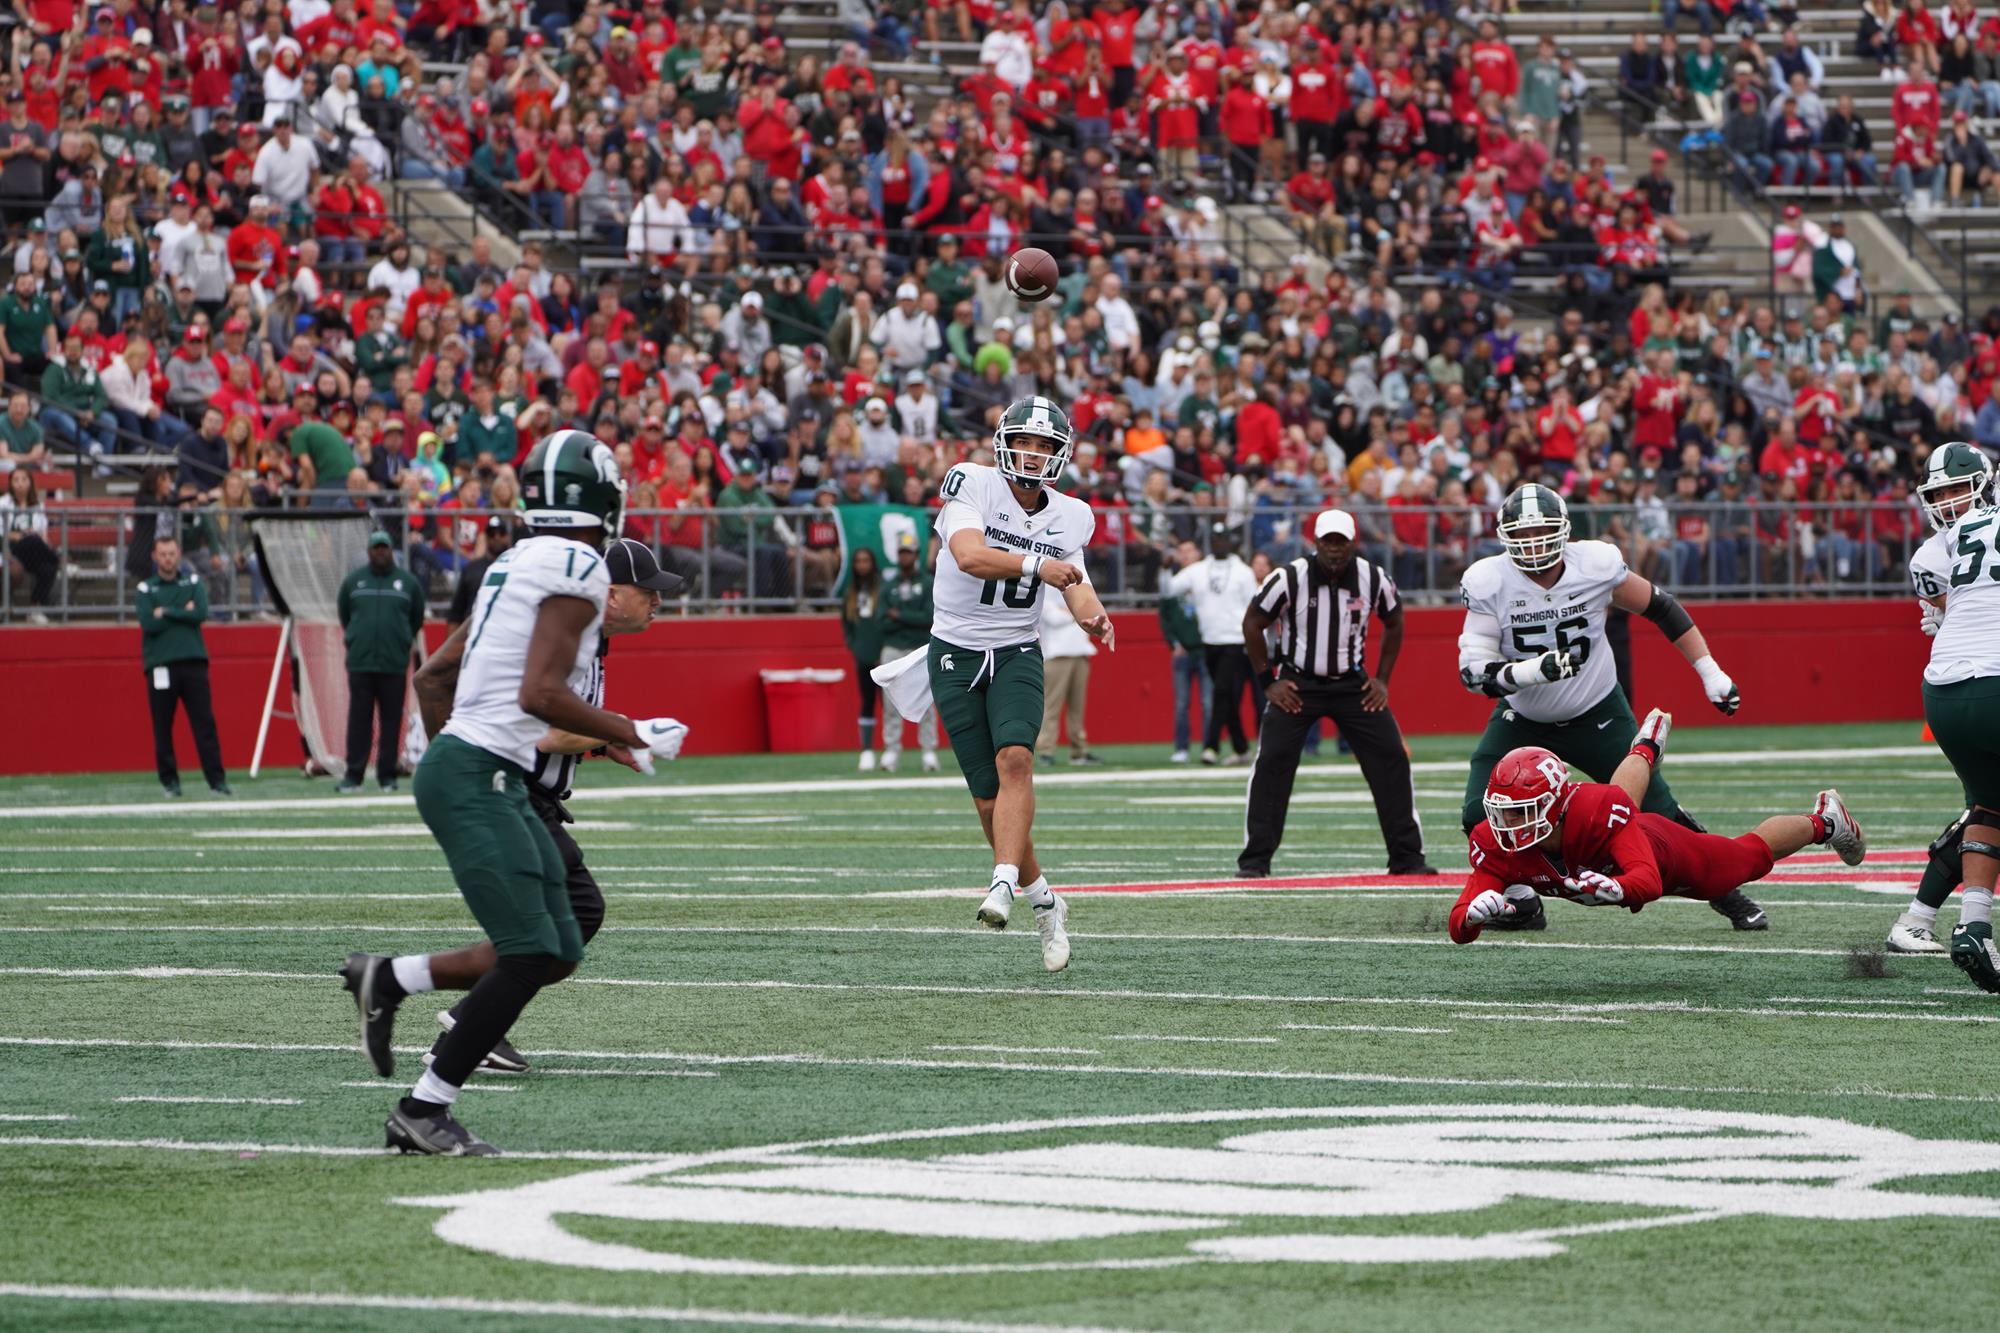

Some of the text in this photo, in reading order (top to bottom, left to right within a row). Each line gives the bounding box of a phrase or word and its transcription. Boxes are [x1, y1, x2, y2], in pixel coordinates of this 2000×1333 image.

[942, 469, 966, 497] 10
[984, 525, 1064, 559] MICHIGAN STATE
[564, 547, 599, 581] 17
[1913, 570, 1940, 596] 76
[1510, 601, 1588, 624] MICHIGAN STATE
[1511, 616, 1591, 665] 56
[1536, 757, 1571, 790] R
[1607, 803, 1631, 829] 71
[1471, 840, 1486, 867] 71
